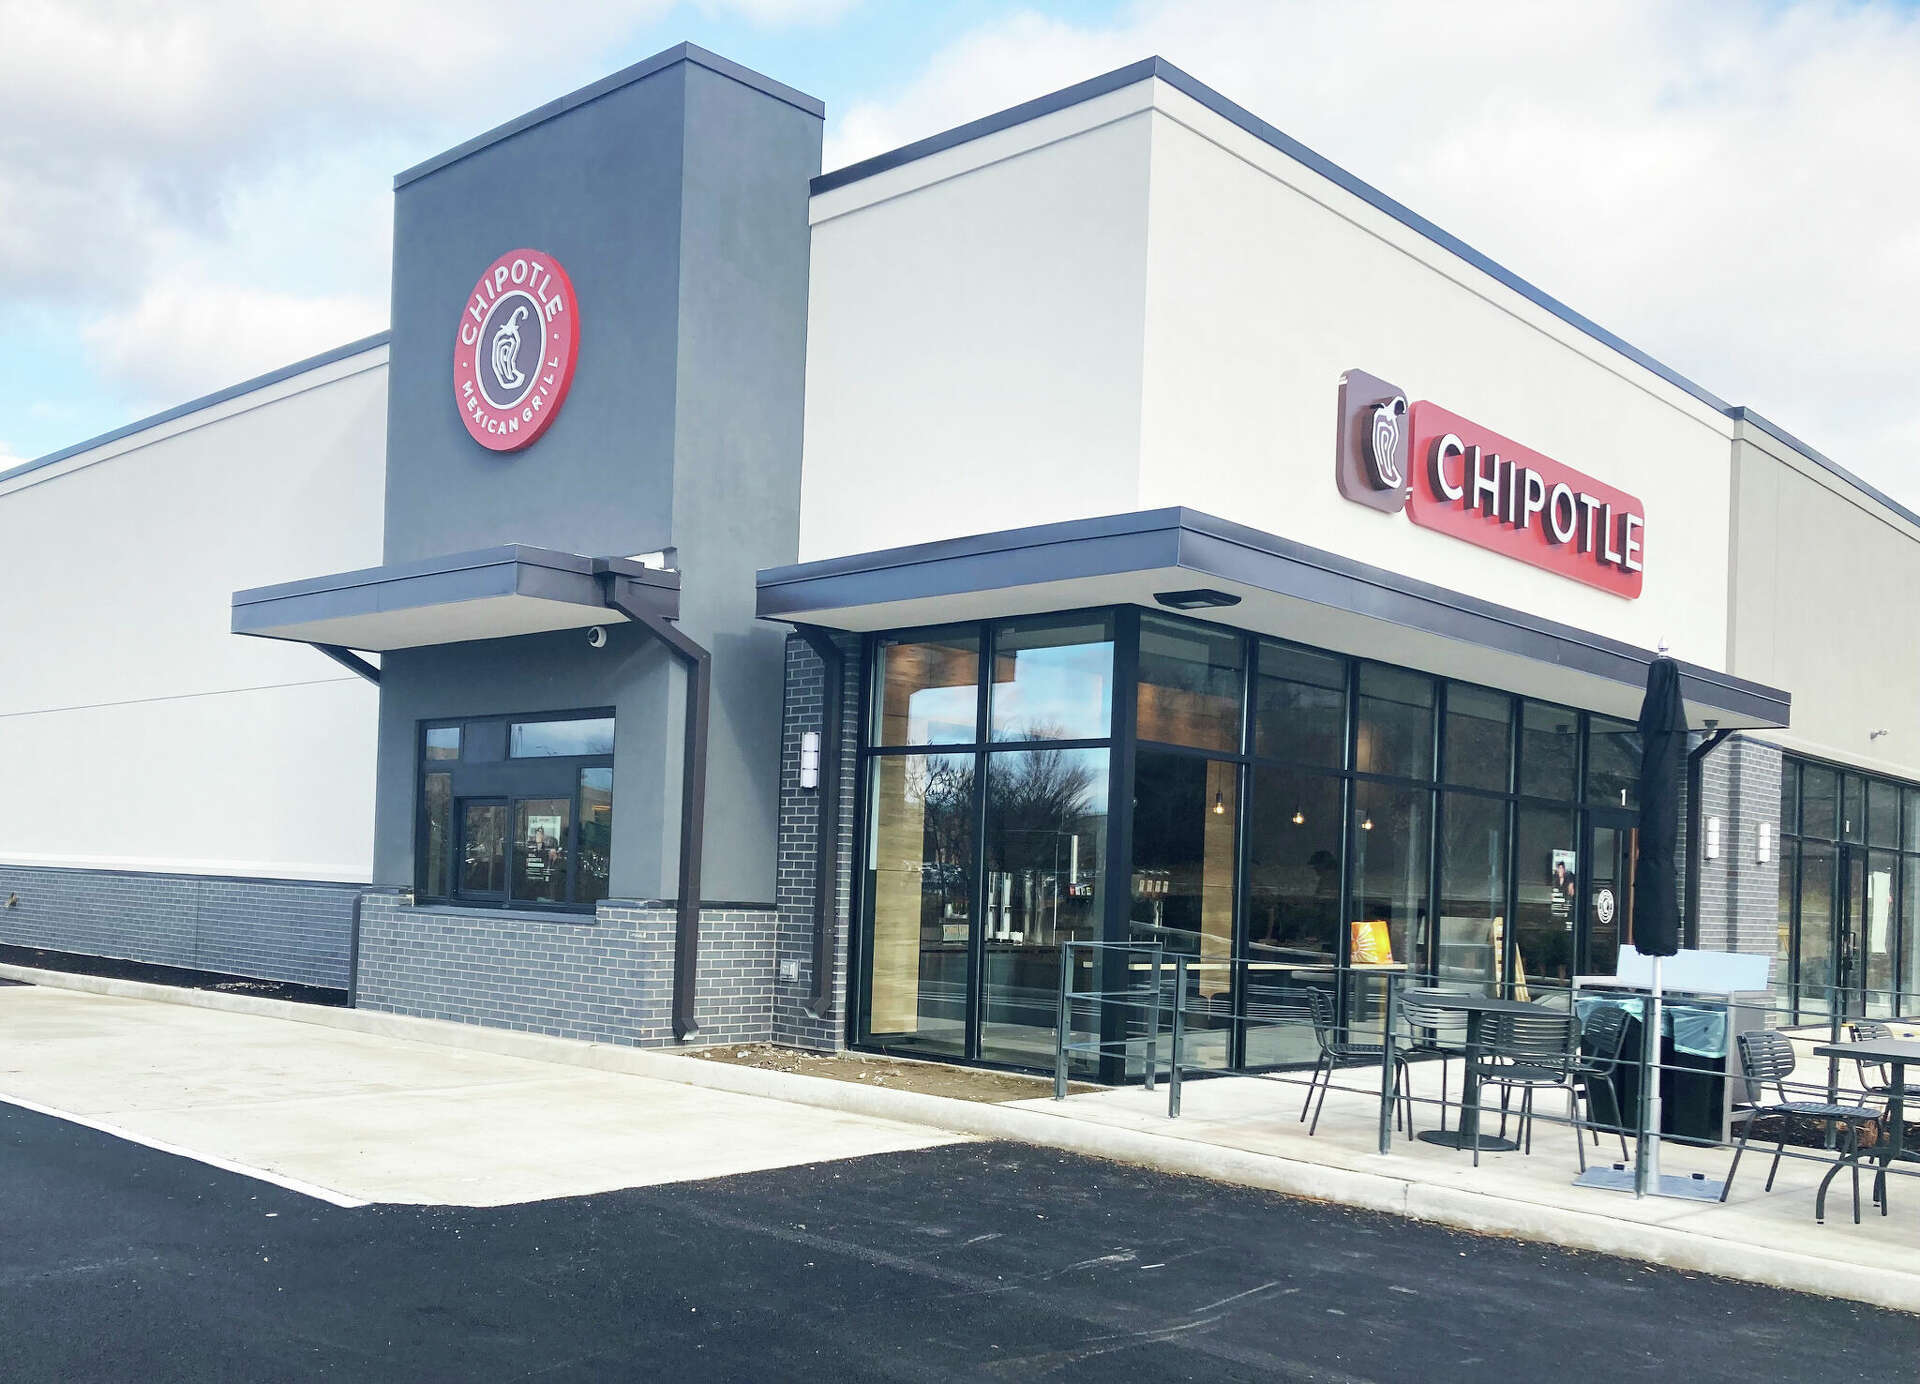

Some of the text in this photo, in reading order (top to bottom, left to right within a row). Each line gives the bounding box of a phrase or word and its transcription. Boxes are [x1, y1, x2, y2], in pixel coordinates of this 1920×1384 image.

[461, 259, 563, 346] CHIPOTLE
[462, 357, 559, 435] MEXICAN GRILL
[1428, 433, 1644, 573] CHIPOTLE
